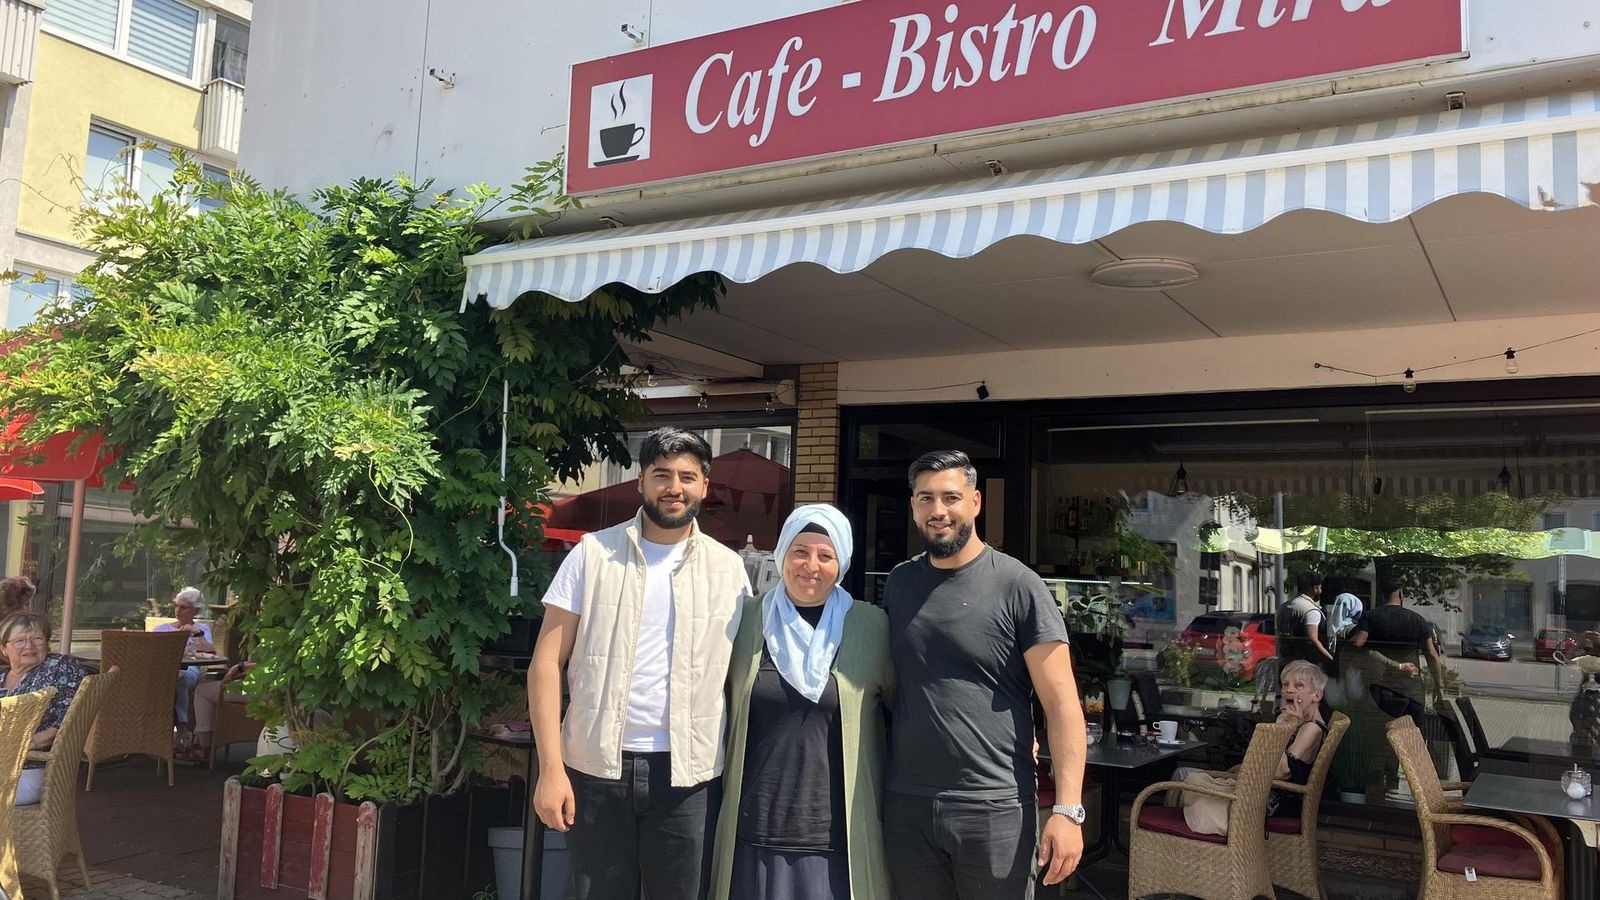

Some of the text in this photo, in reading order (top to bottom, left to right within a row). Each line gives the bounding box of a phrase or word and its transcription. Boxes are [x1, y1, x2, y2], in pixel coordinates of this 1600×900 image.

[684, 36, 823, 147] Cafe
[841, 71, 862, 89] -
[872, 3, 1098, 103] Bistro
